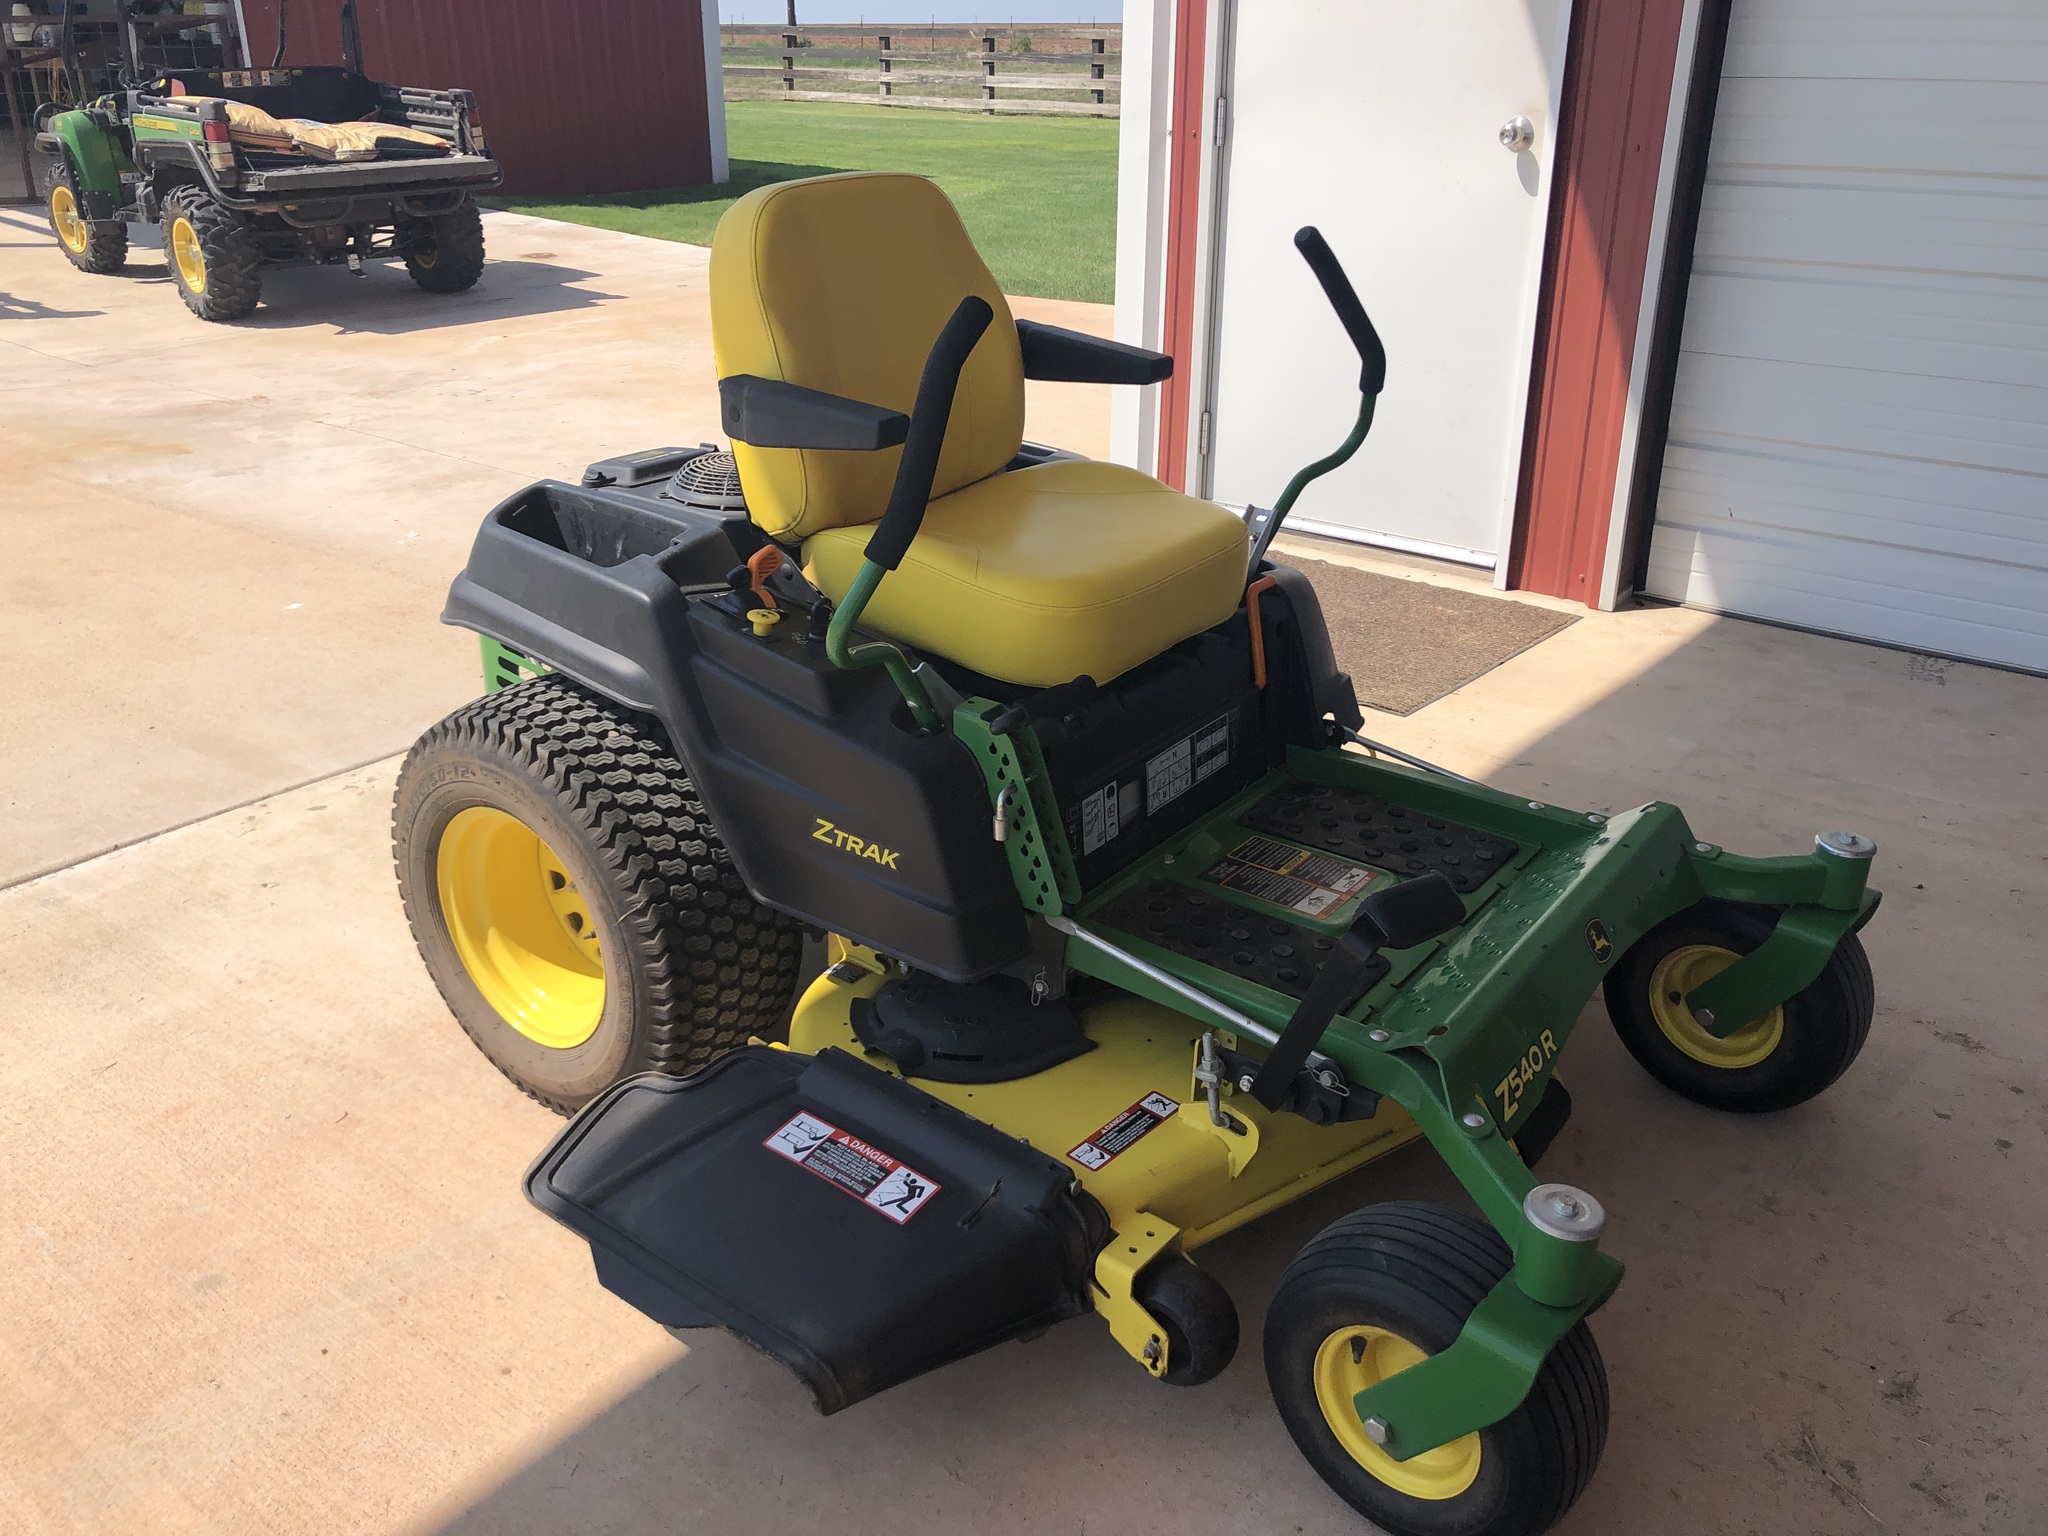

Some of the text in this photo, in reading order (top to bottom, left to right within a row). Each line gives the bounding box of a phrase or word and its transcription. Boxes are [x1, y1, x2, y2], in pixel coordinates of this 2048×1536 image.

[812, 818, 900, 870] ZTRAK
[1104, 1111, 1130, 1130] DANGER
[849, 1140, 894, 1167] DANGER
